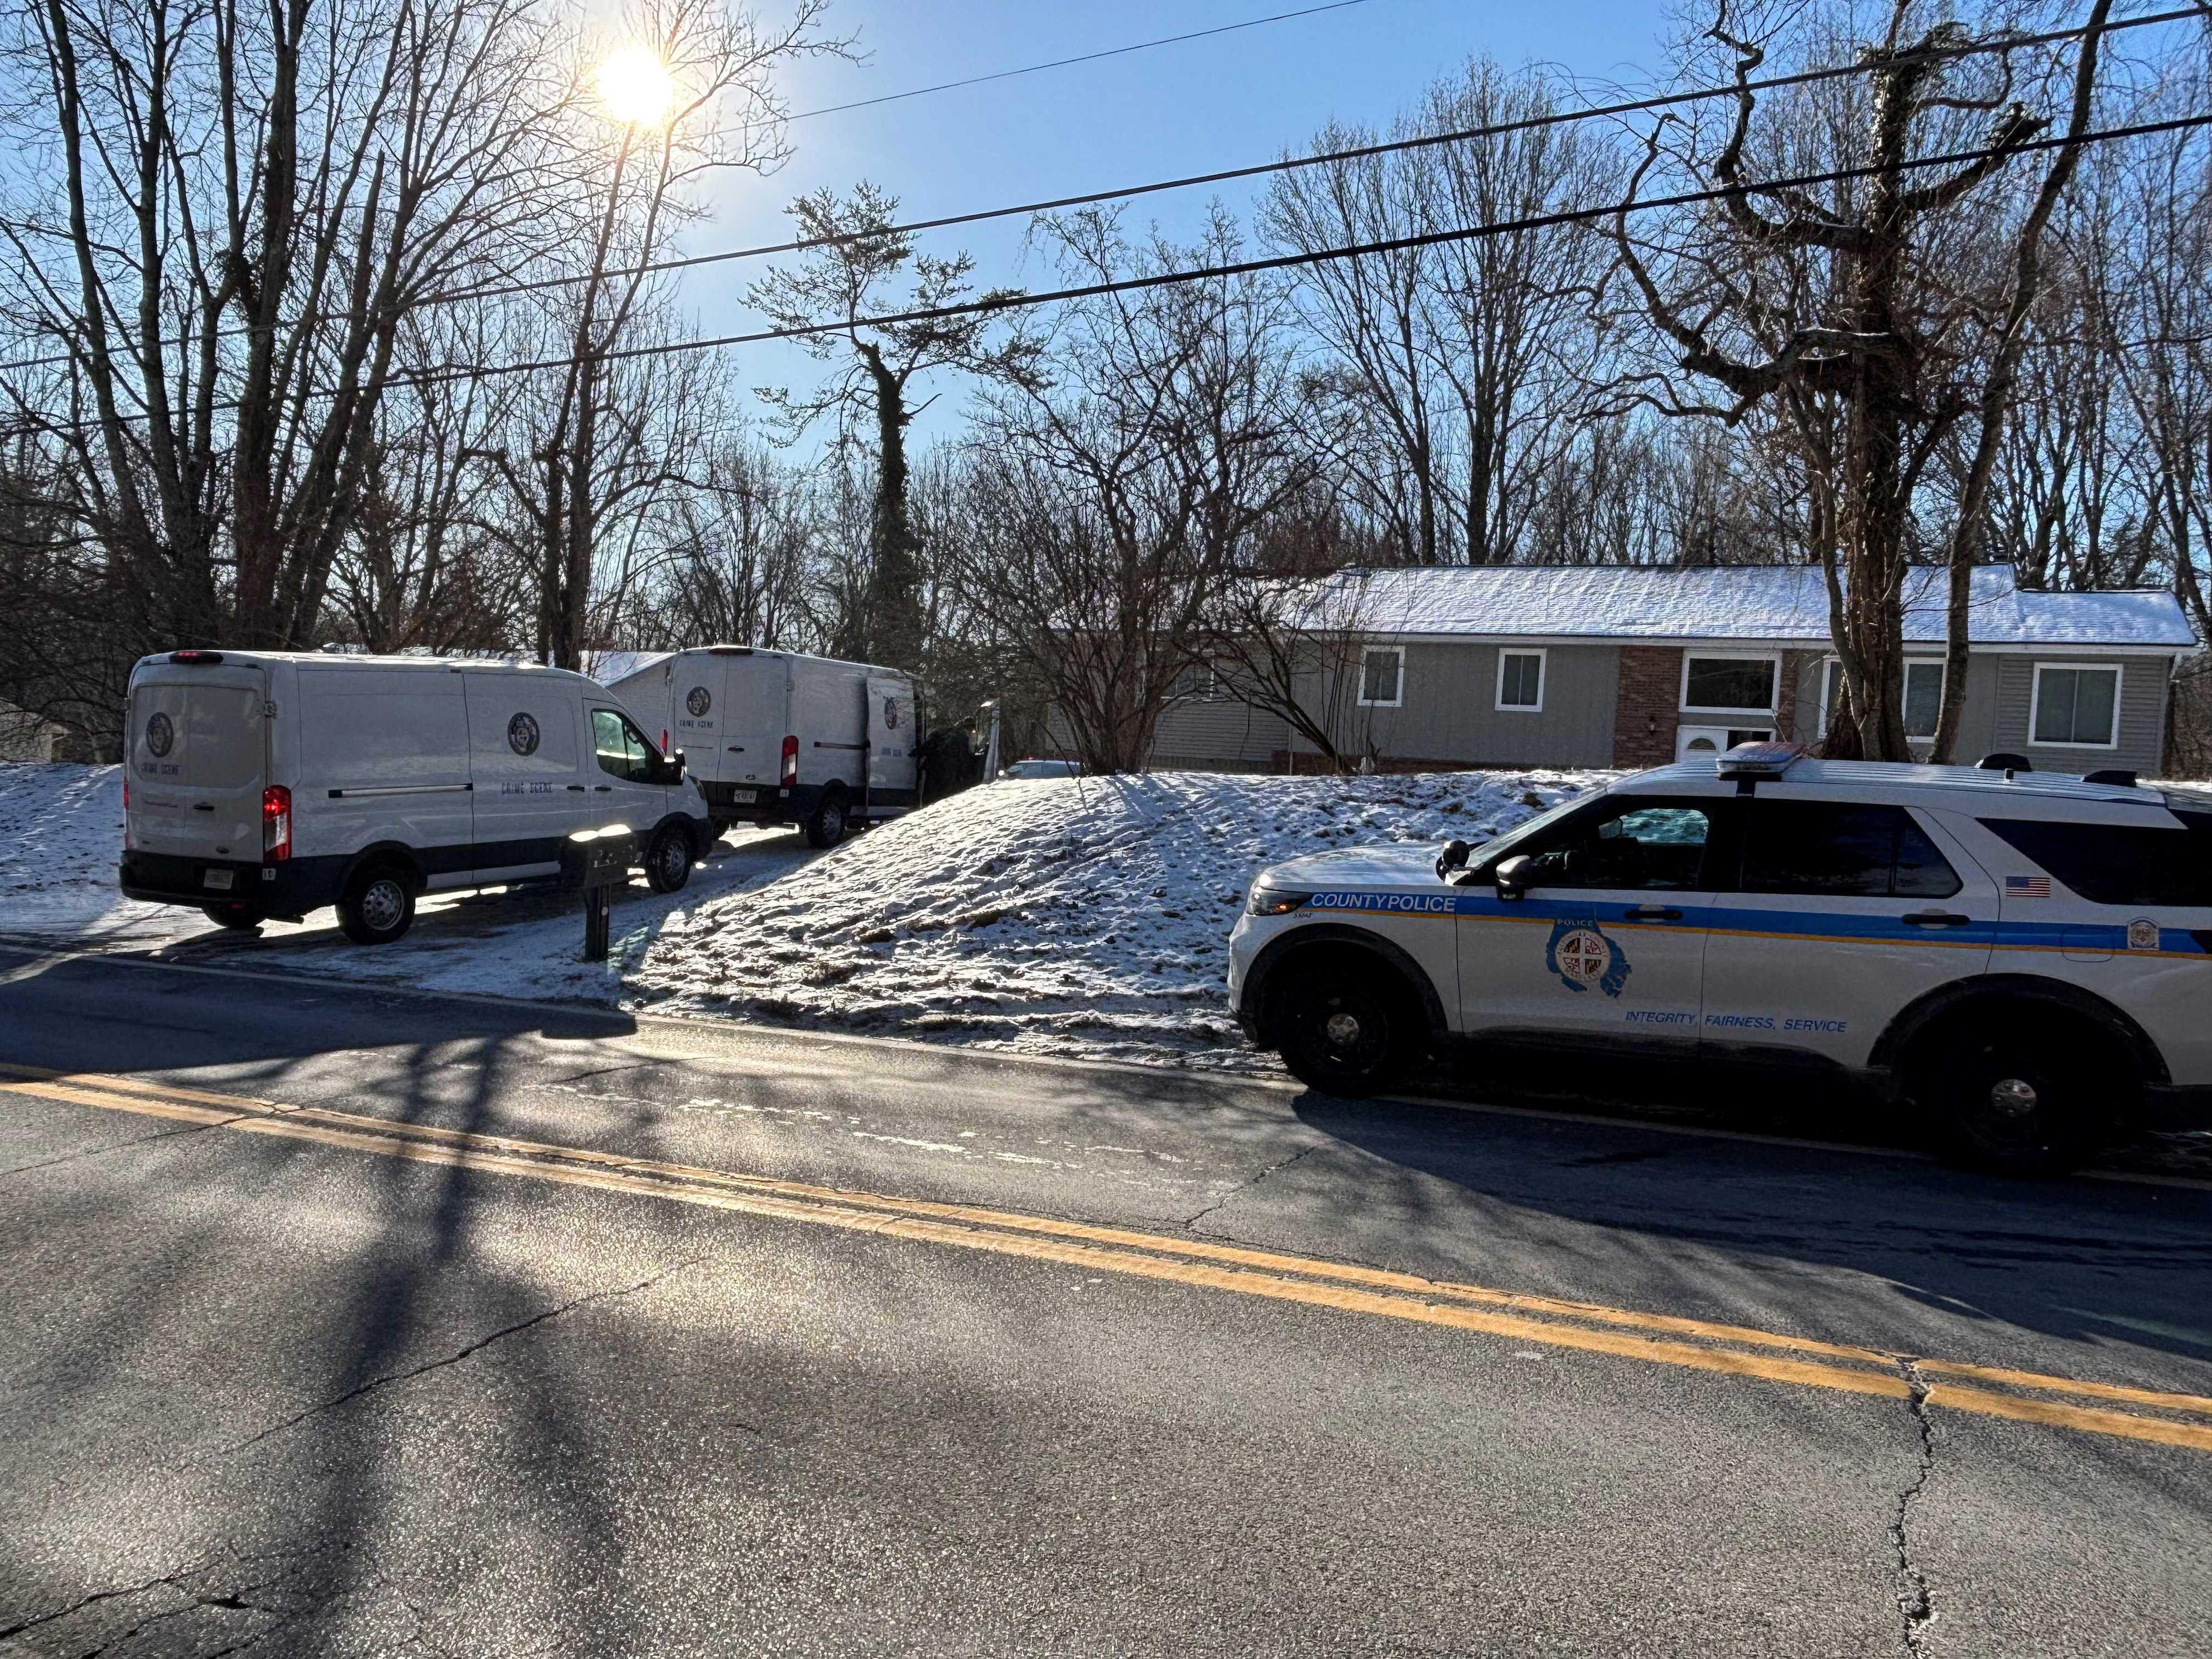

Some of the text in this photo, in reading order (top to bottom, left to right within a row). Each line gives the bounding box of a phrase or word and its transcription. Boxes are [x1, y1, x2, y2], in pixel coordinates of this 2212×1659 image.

[1312, 894, 1456, 912] COUNTY POLICE
[1557, 918, 1594, 927] POLICE
[1626, 1011, 1847, 1033] INTEGRITY, FAIRNESS, SERVICE
